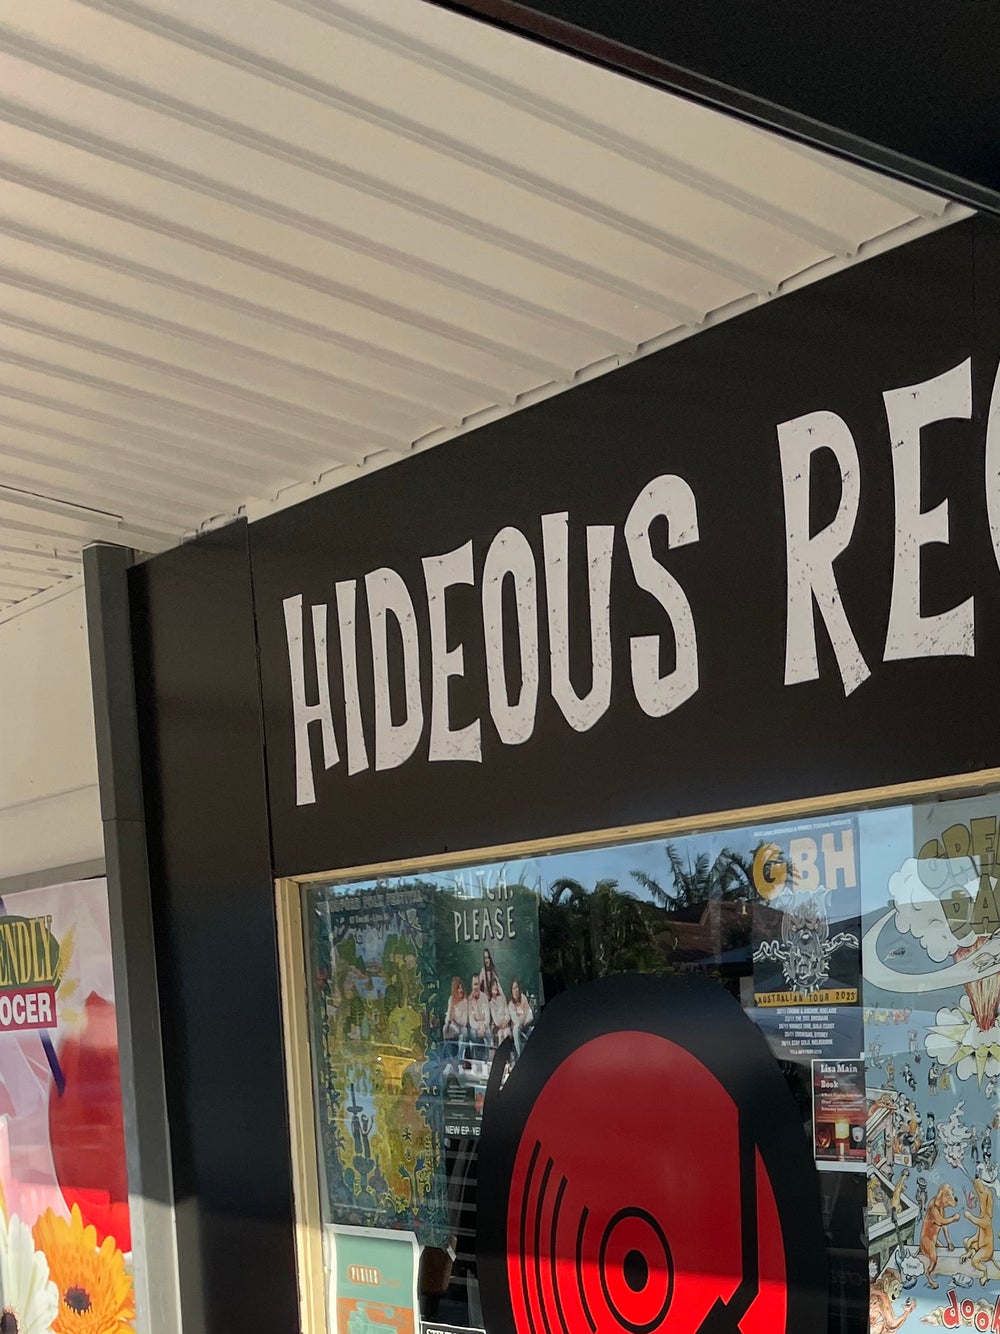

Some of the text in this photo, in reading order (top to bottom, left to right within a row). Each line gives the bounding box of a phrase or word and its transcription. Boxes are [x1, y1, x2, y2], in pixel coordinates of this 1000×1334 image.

[283, 474, 700, 806] HIDEOUS
[753, 829, 857, 900] GBH
[453, 905, 516, 943] PLEASE
[0, 992, 53, 1026] OCER
[758, 987, 856, 1004] AUSTRALIAN TOUR 2023
[820, 1063, 857, 1073] Lisa Main
[821, 1080, 839, 1088] Book
